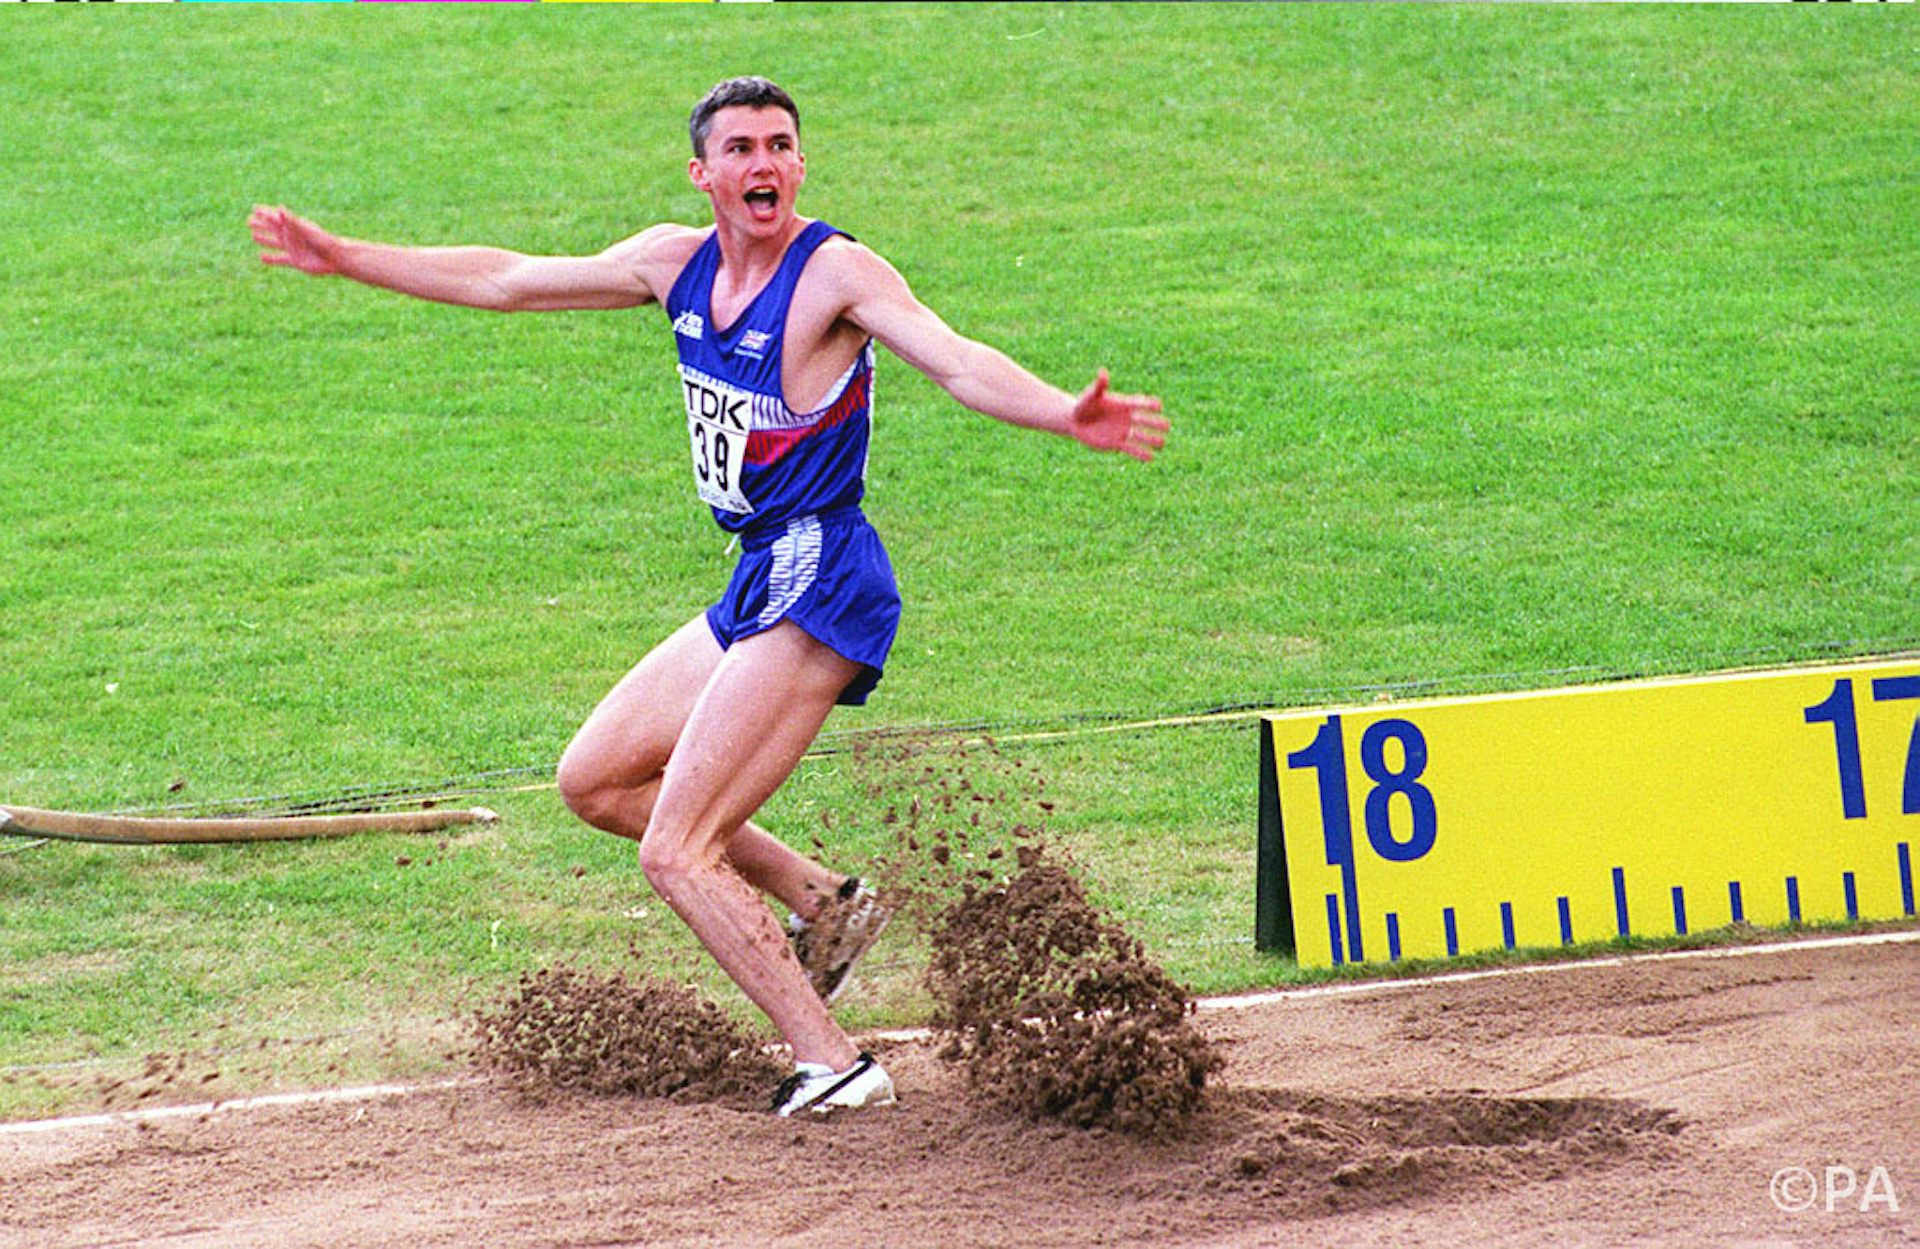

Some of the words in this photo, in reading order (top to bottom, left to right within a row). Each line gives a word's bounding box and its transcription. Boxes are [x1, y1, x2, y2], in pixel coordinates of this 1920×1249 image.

[684, 379, 748, 431] TDK
[694, 421, 729, 492] 39
[1288, 715, 1438, 865] 18
